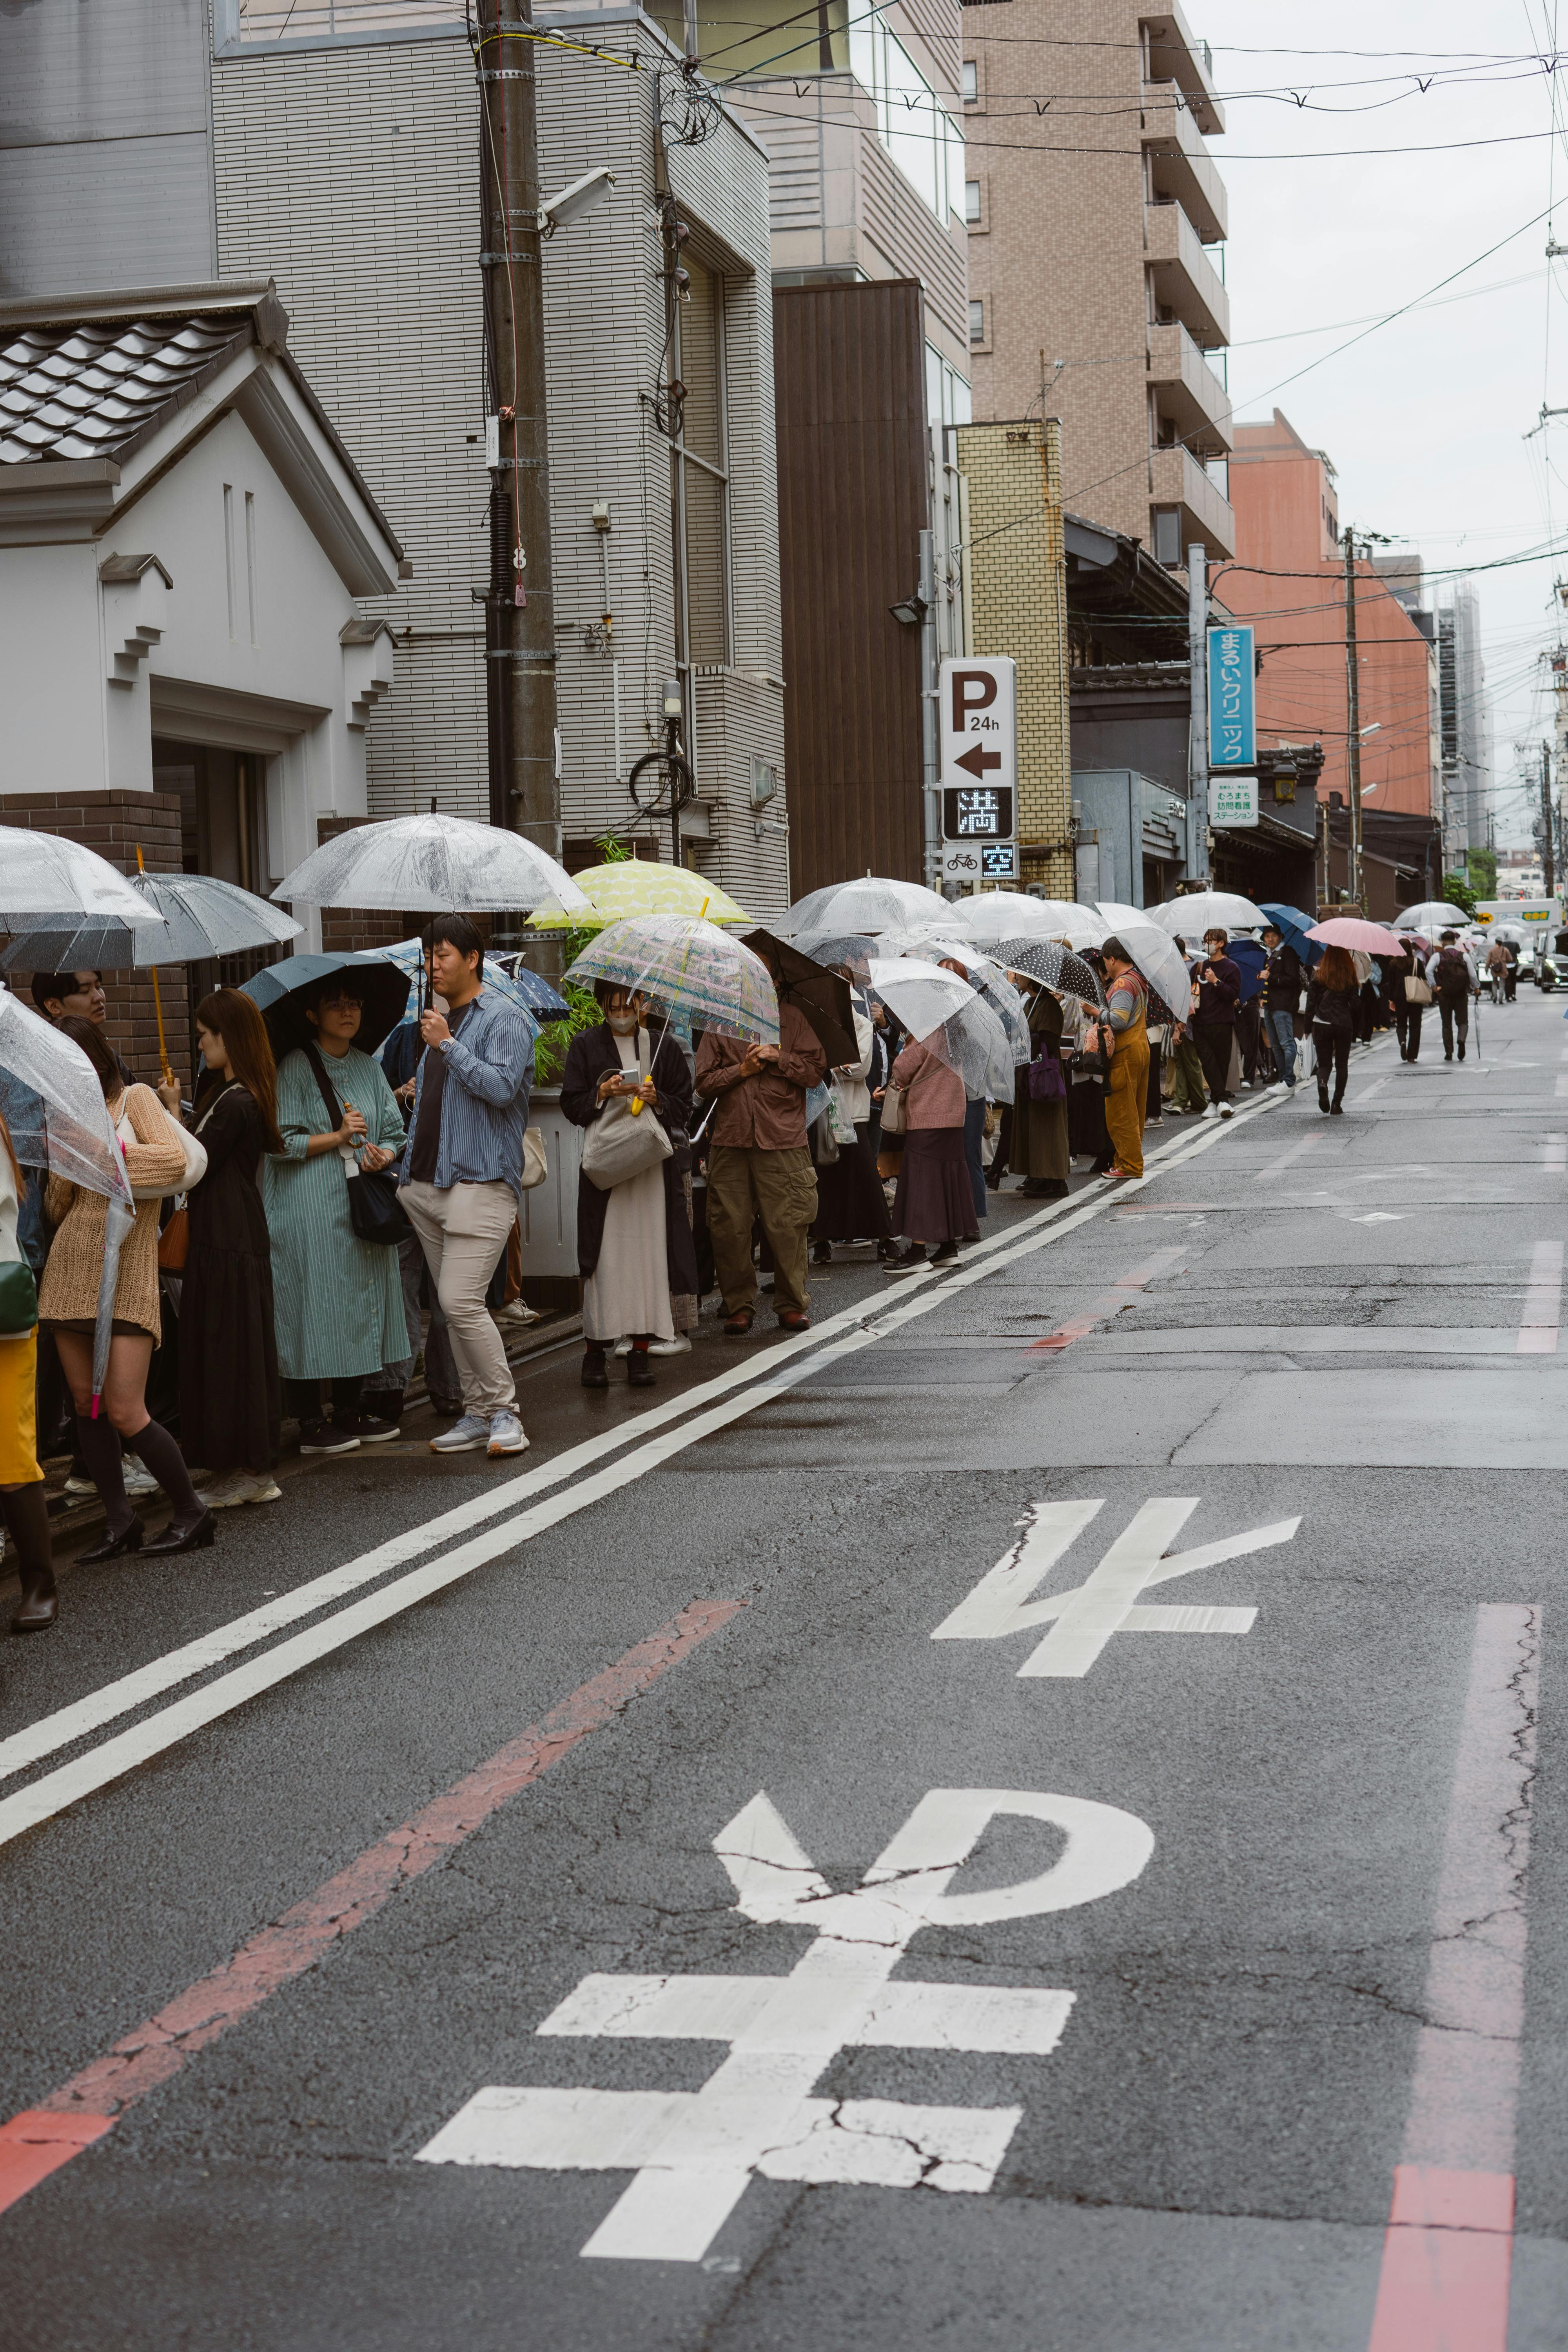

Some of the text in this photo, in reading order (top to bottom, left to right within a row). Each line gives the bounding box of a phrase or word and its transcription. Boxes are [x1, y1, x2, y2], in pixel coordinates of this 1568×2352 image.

[952, 671, 998, 732] P
[1220, 633, 1242, 761] まるいクリニック
[971, 716, 999, 731] 24h
[959, 789, 999, 835] 満
[1214, 811, 1254, 820] ステーション
[1217, 801, 1250, 810] 訪問看護
[983, 845, 1014, 877] 空
